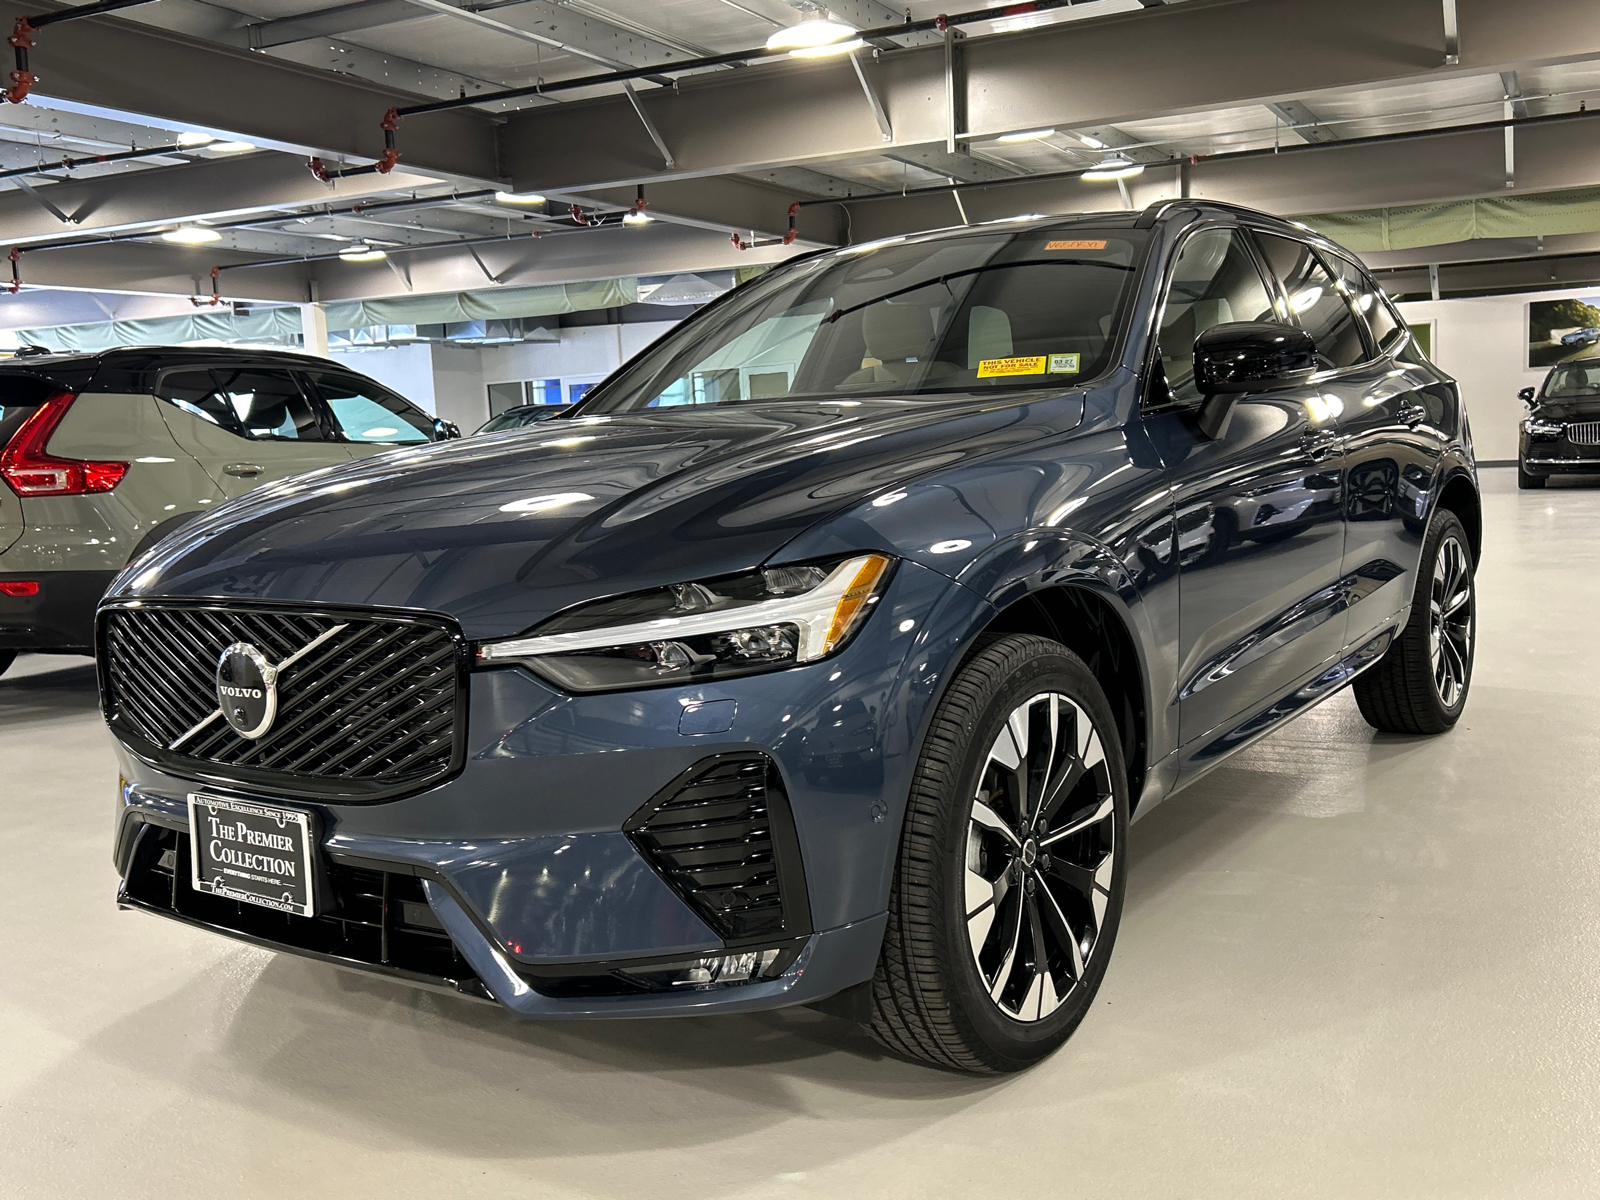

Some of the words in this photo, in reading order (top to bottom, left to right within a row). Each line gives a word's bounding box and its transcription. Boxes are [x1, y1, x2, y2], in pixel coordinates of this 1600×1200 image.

[220, 685, 262, 699] VOLVO
[208, 816, 236, 841] THE
[236, 822, 294, 852] PREMIER
[209, 839, 296, 877] COLLECTION
[223, 868, 251, 879] EVERYTHING
[250, 874, 268, 884] STARTS
